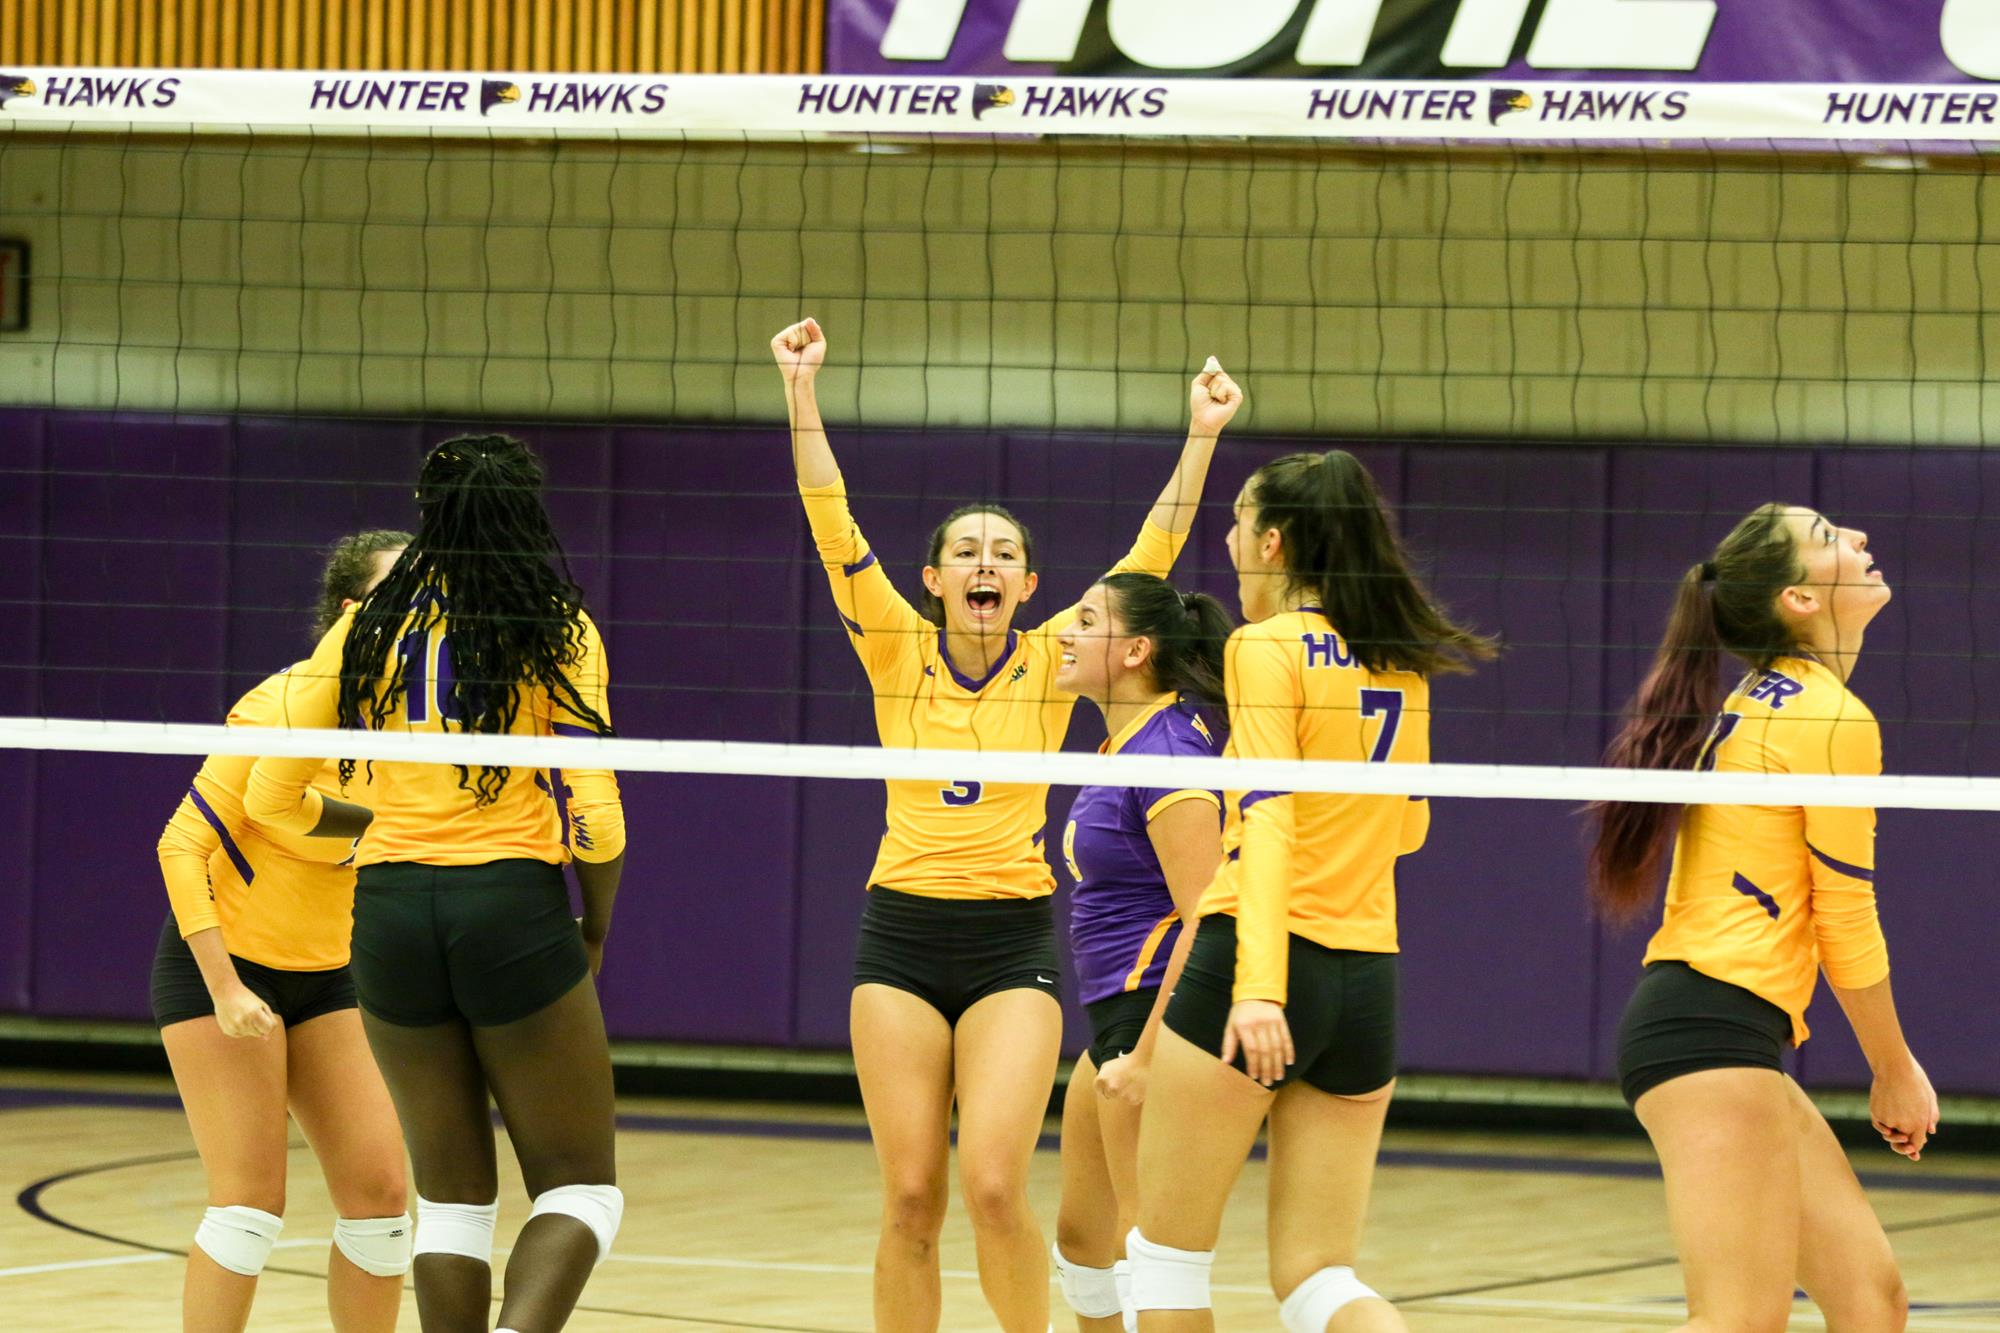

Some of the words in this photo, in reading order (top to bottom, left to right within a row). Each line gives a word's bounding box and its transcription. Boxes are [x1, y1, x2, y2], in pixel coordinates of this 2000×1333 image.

[43, 76, 181, 108] HAWKS
[310, 80, 470, 111] HUNTER
[527, 82, 668, 114] HAWKS
[798, 84, 961, 115] HUNTER
[1022, 86, 1168, 118] HAWKS
[1307, 89, 1477, 120] HUNTER
[1540, 90, 1686, 121] HAWKS
[1824, 92, 1998, 124] HUNTER
[1359, 686, 1404, 763] 7
